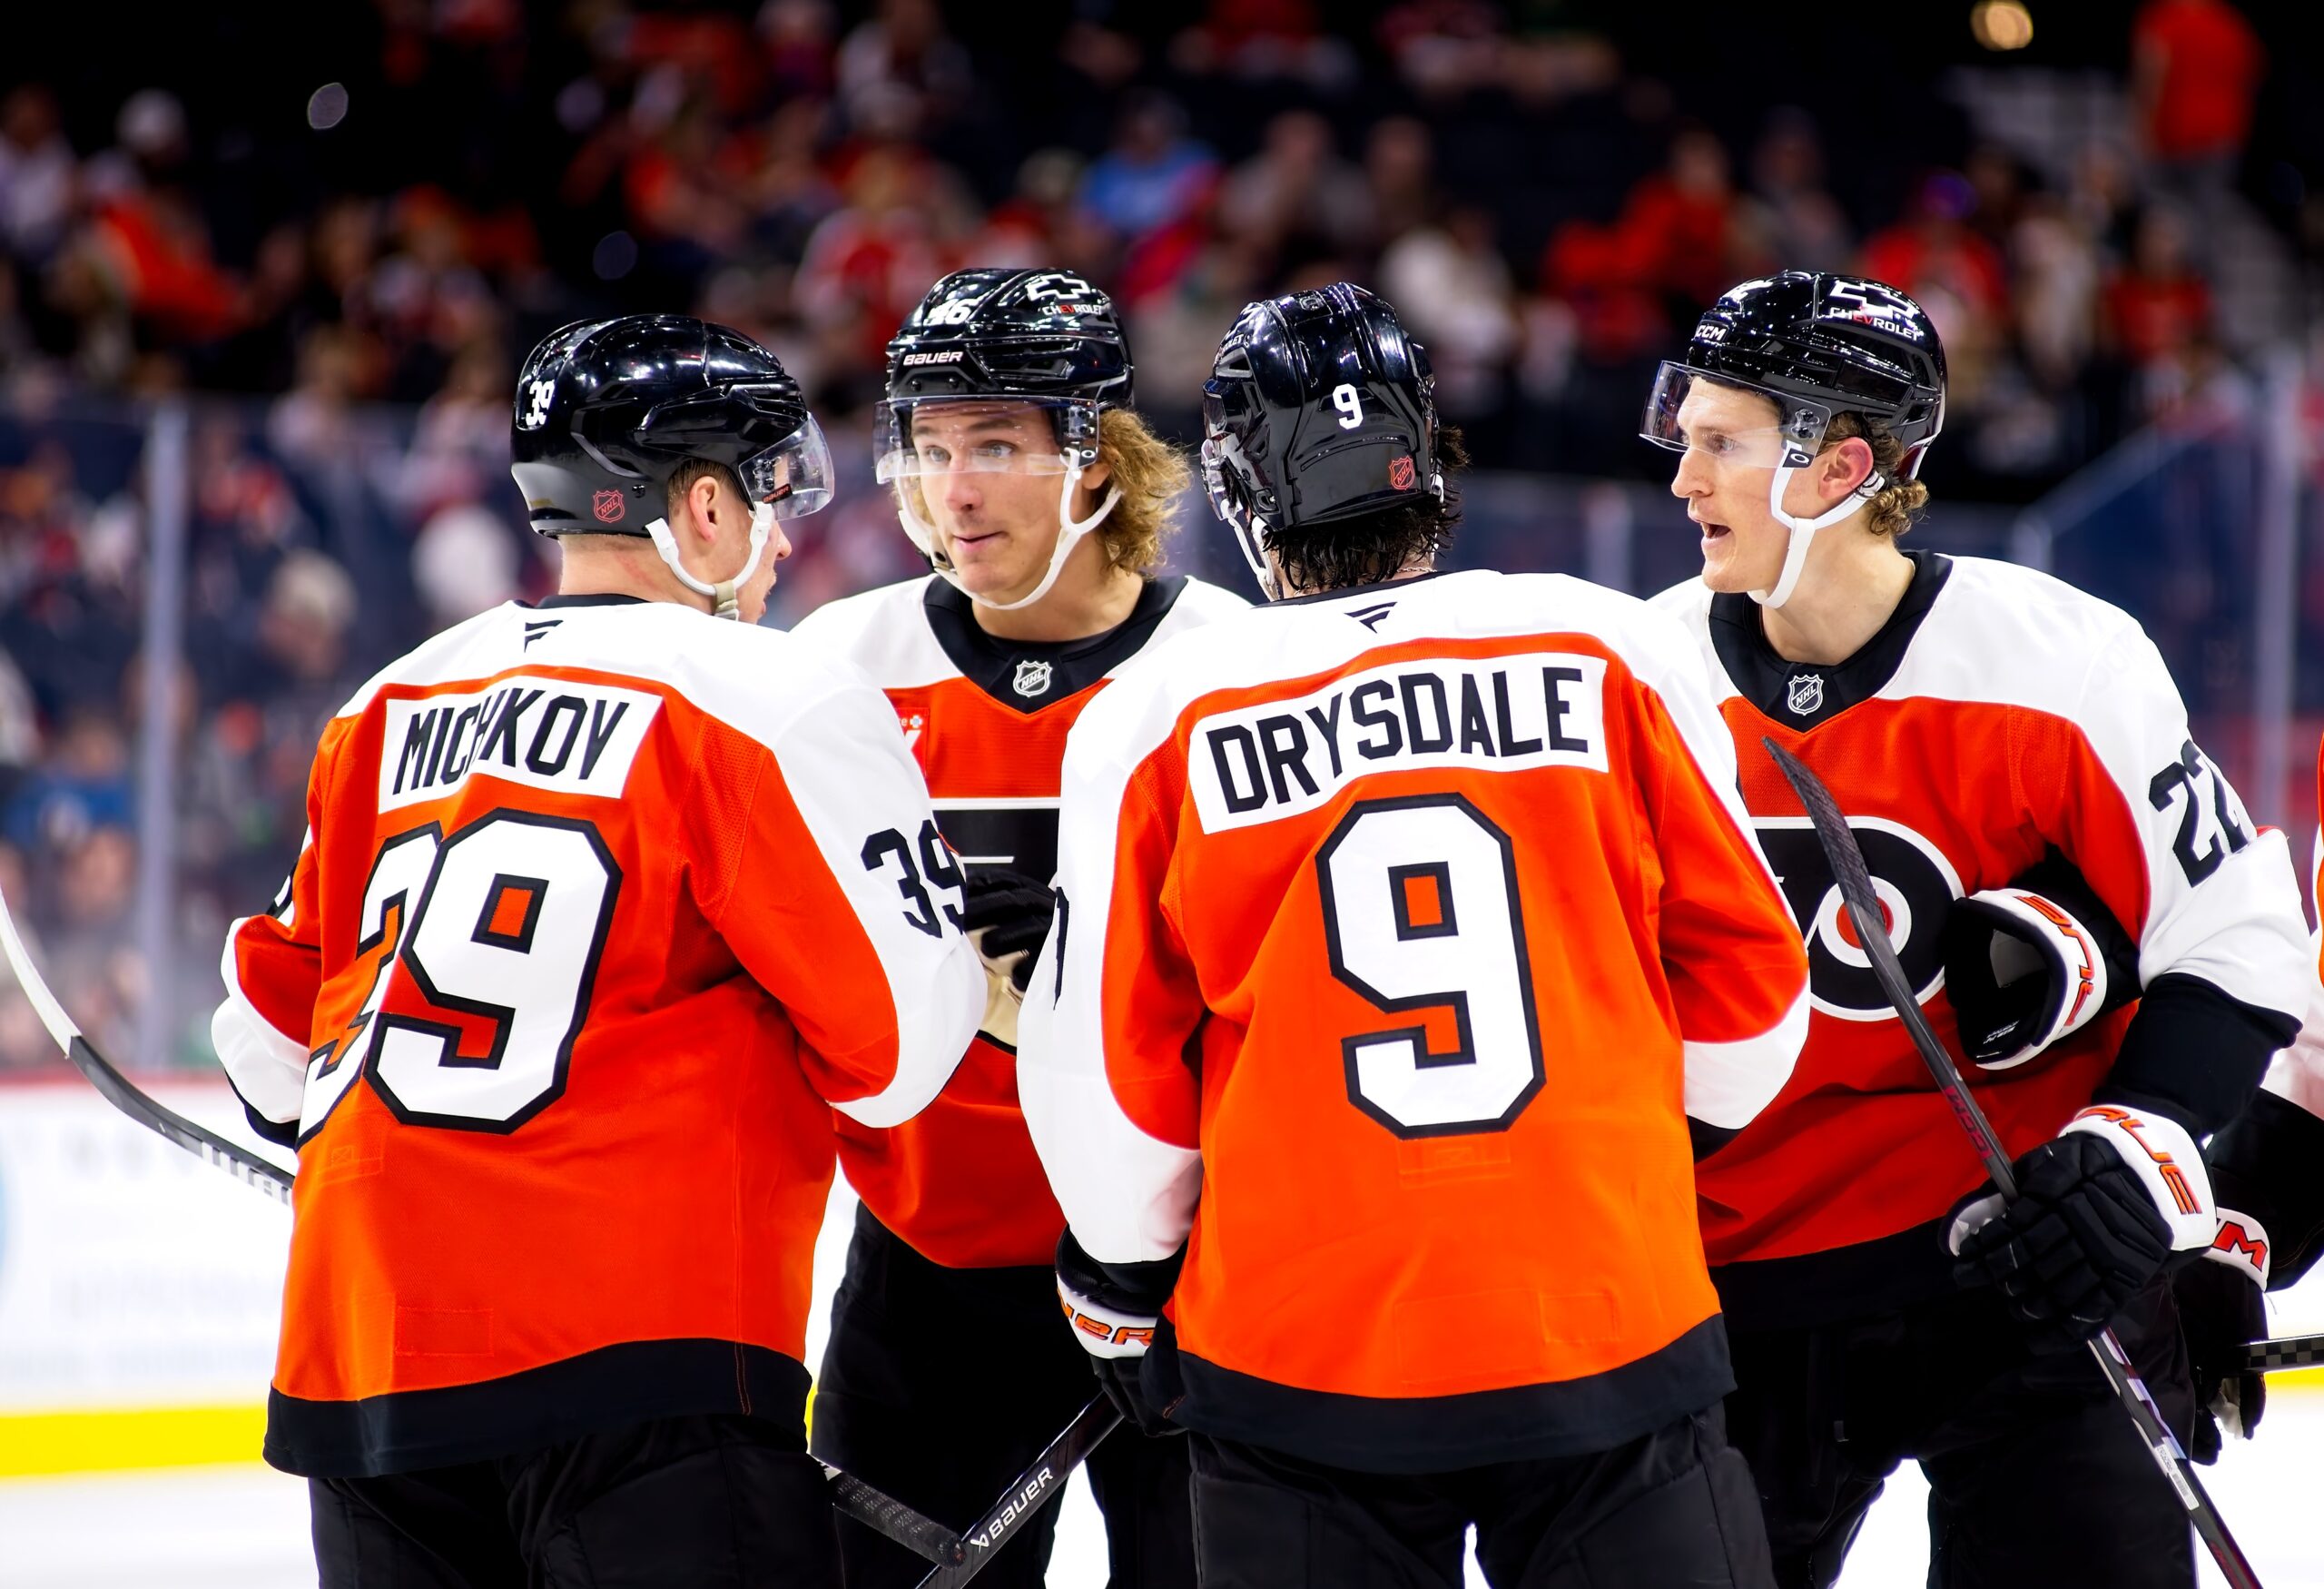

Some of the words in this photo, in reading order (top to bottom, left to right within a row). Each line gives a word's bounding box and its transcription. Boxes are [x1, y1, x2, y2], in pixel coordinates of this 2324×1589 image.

[1042, 304, 1102, 315] CHEVROLET
[1696, 325, 1727, 340] CCM
[1829, 307, 1919, 341] CHEVROLET
[903, 351, 963, 366] BAUER
[526, 380, 556, 426] 39
[1332, 383, 1364, 429] 9
[392, 687, 630, 796] MICHKOV
[1206, 666, 1589, 814] DRYSDALE
[860, 819, 968, 939] 39
[294, 806, 624, 1153] 39
[1315, 792, 1547, 1140] 9
[988, 1466, 1054, 1541] BAUER
